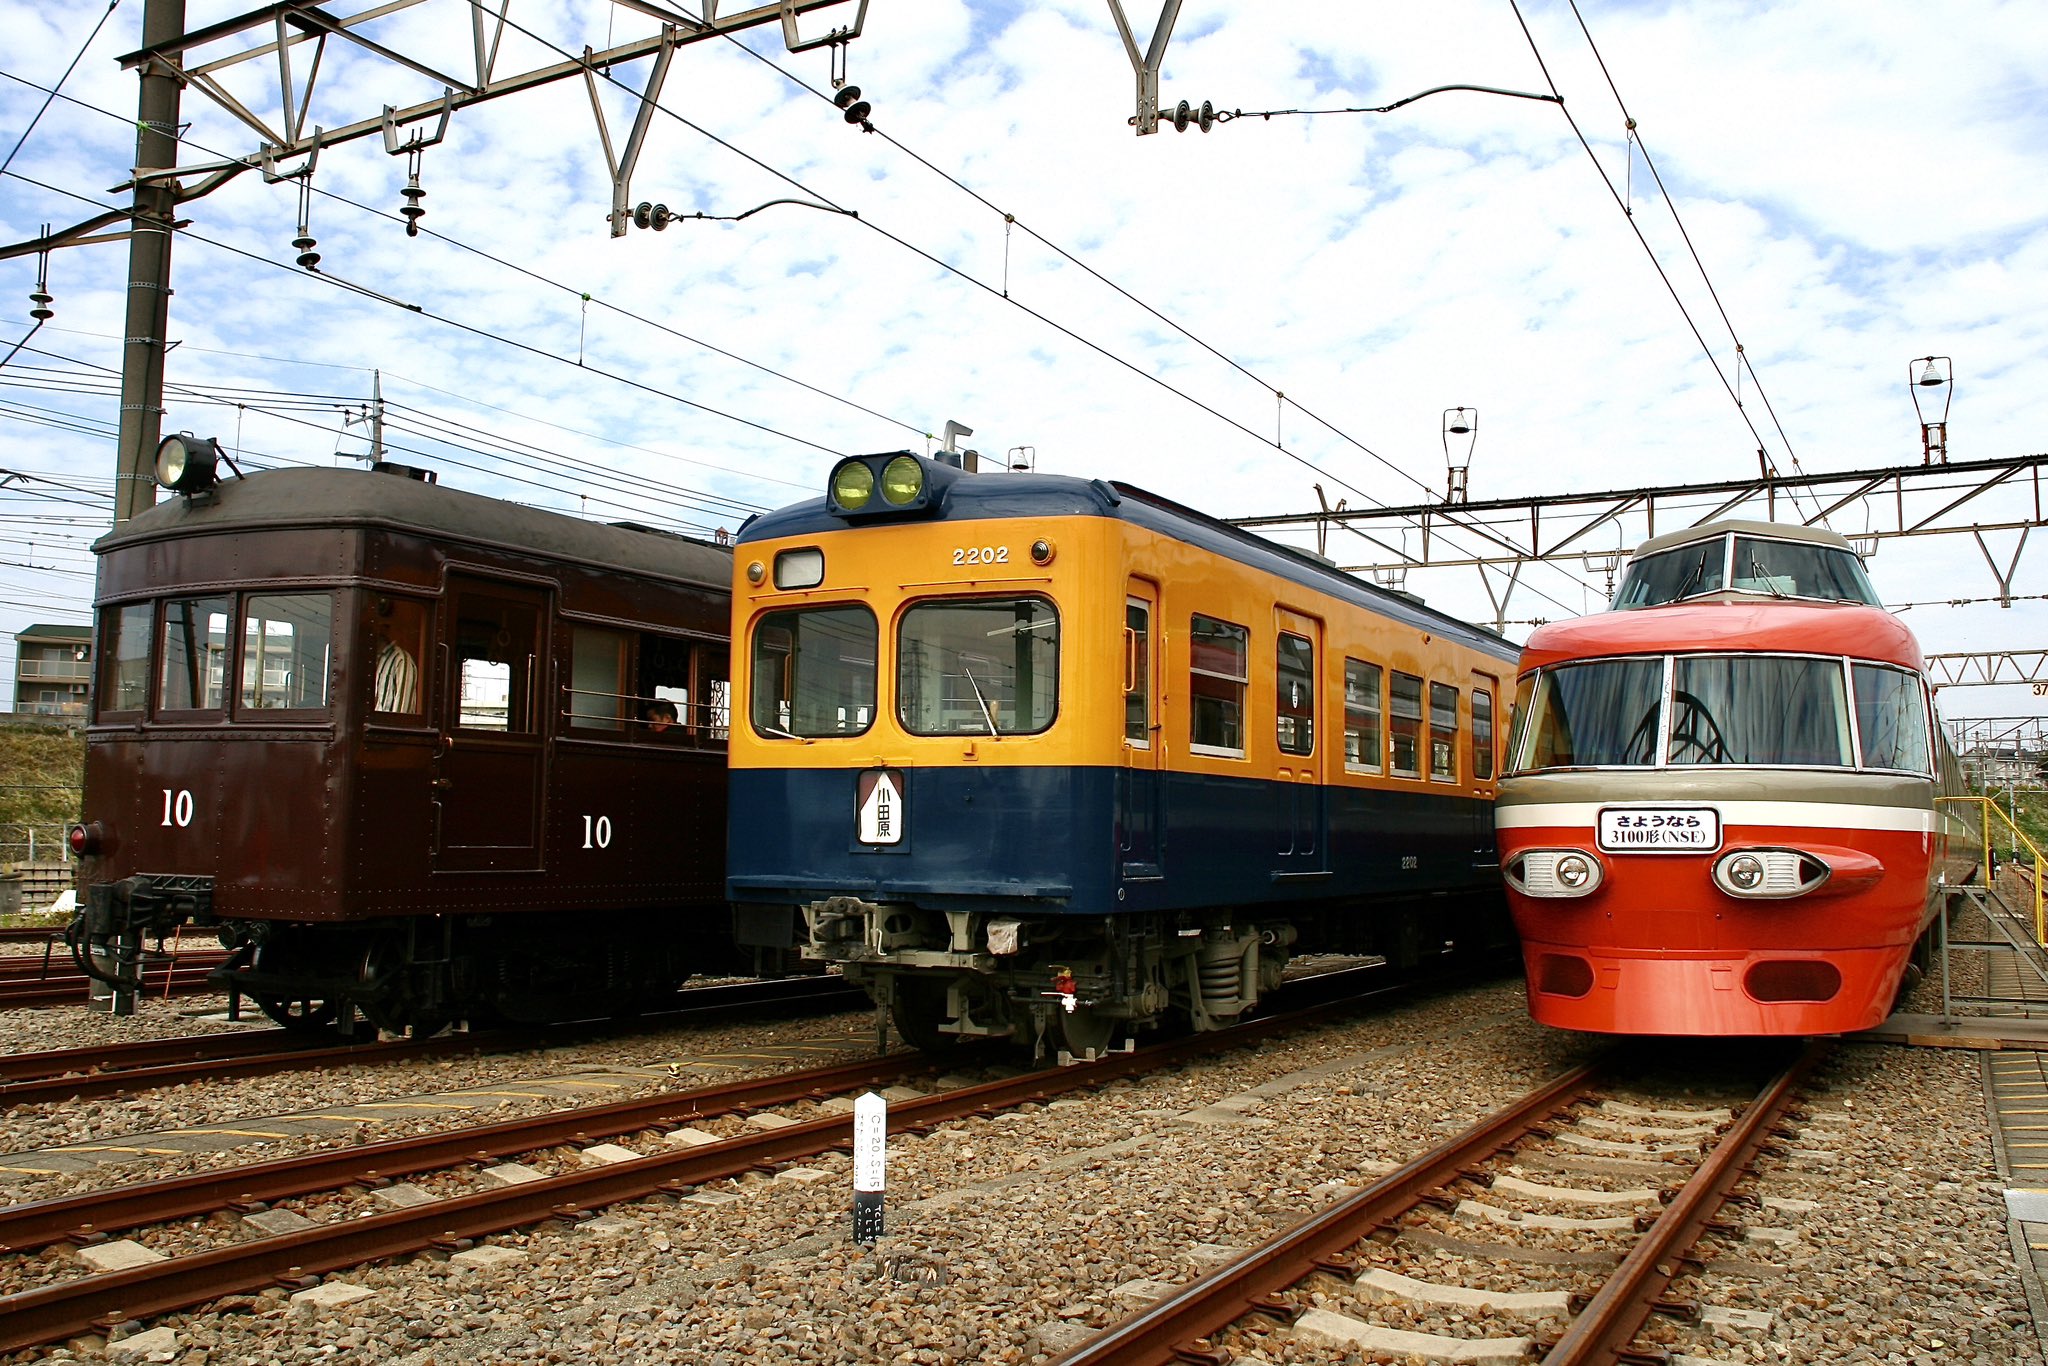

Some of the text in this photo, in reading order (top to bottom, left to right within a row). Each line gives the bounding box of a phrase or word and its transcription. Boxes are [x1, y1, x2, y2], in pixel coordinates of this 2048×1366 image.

[953, 546, 1009, 565] 2202
[161, 789, 193, 827] 10
[877, 788, 891, 837] 小田原
[582, 815, 612, 849] 10
[1617, 815, 1701, 828] さようなら
[1401, 856, 1417, 870] 2202
